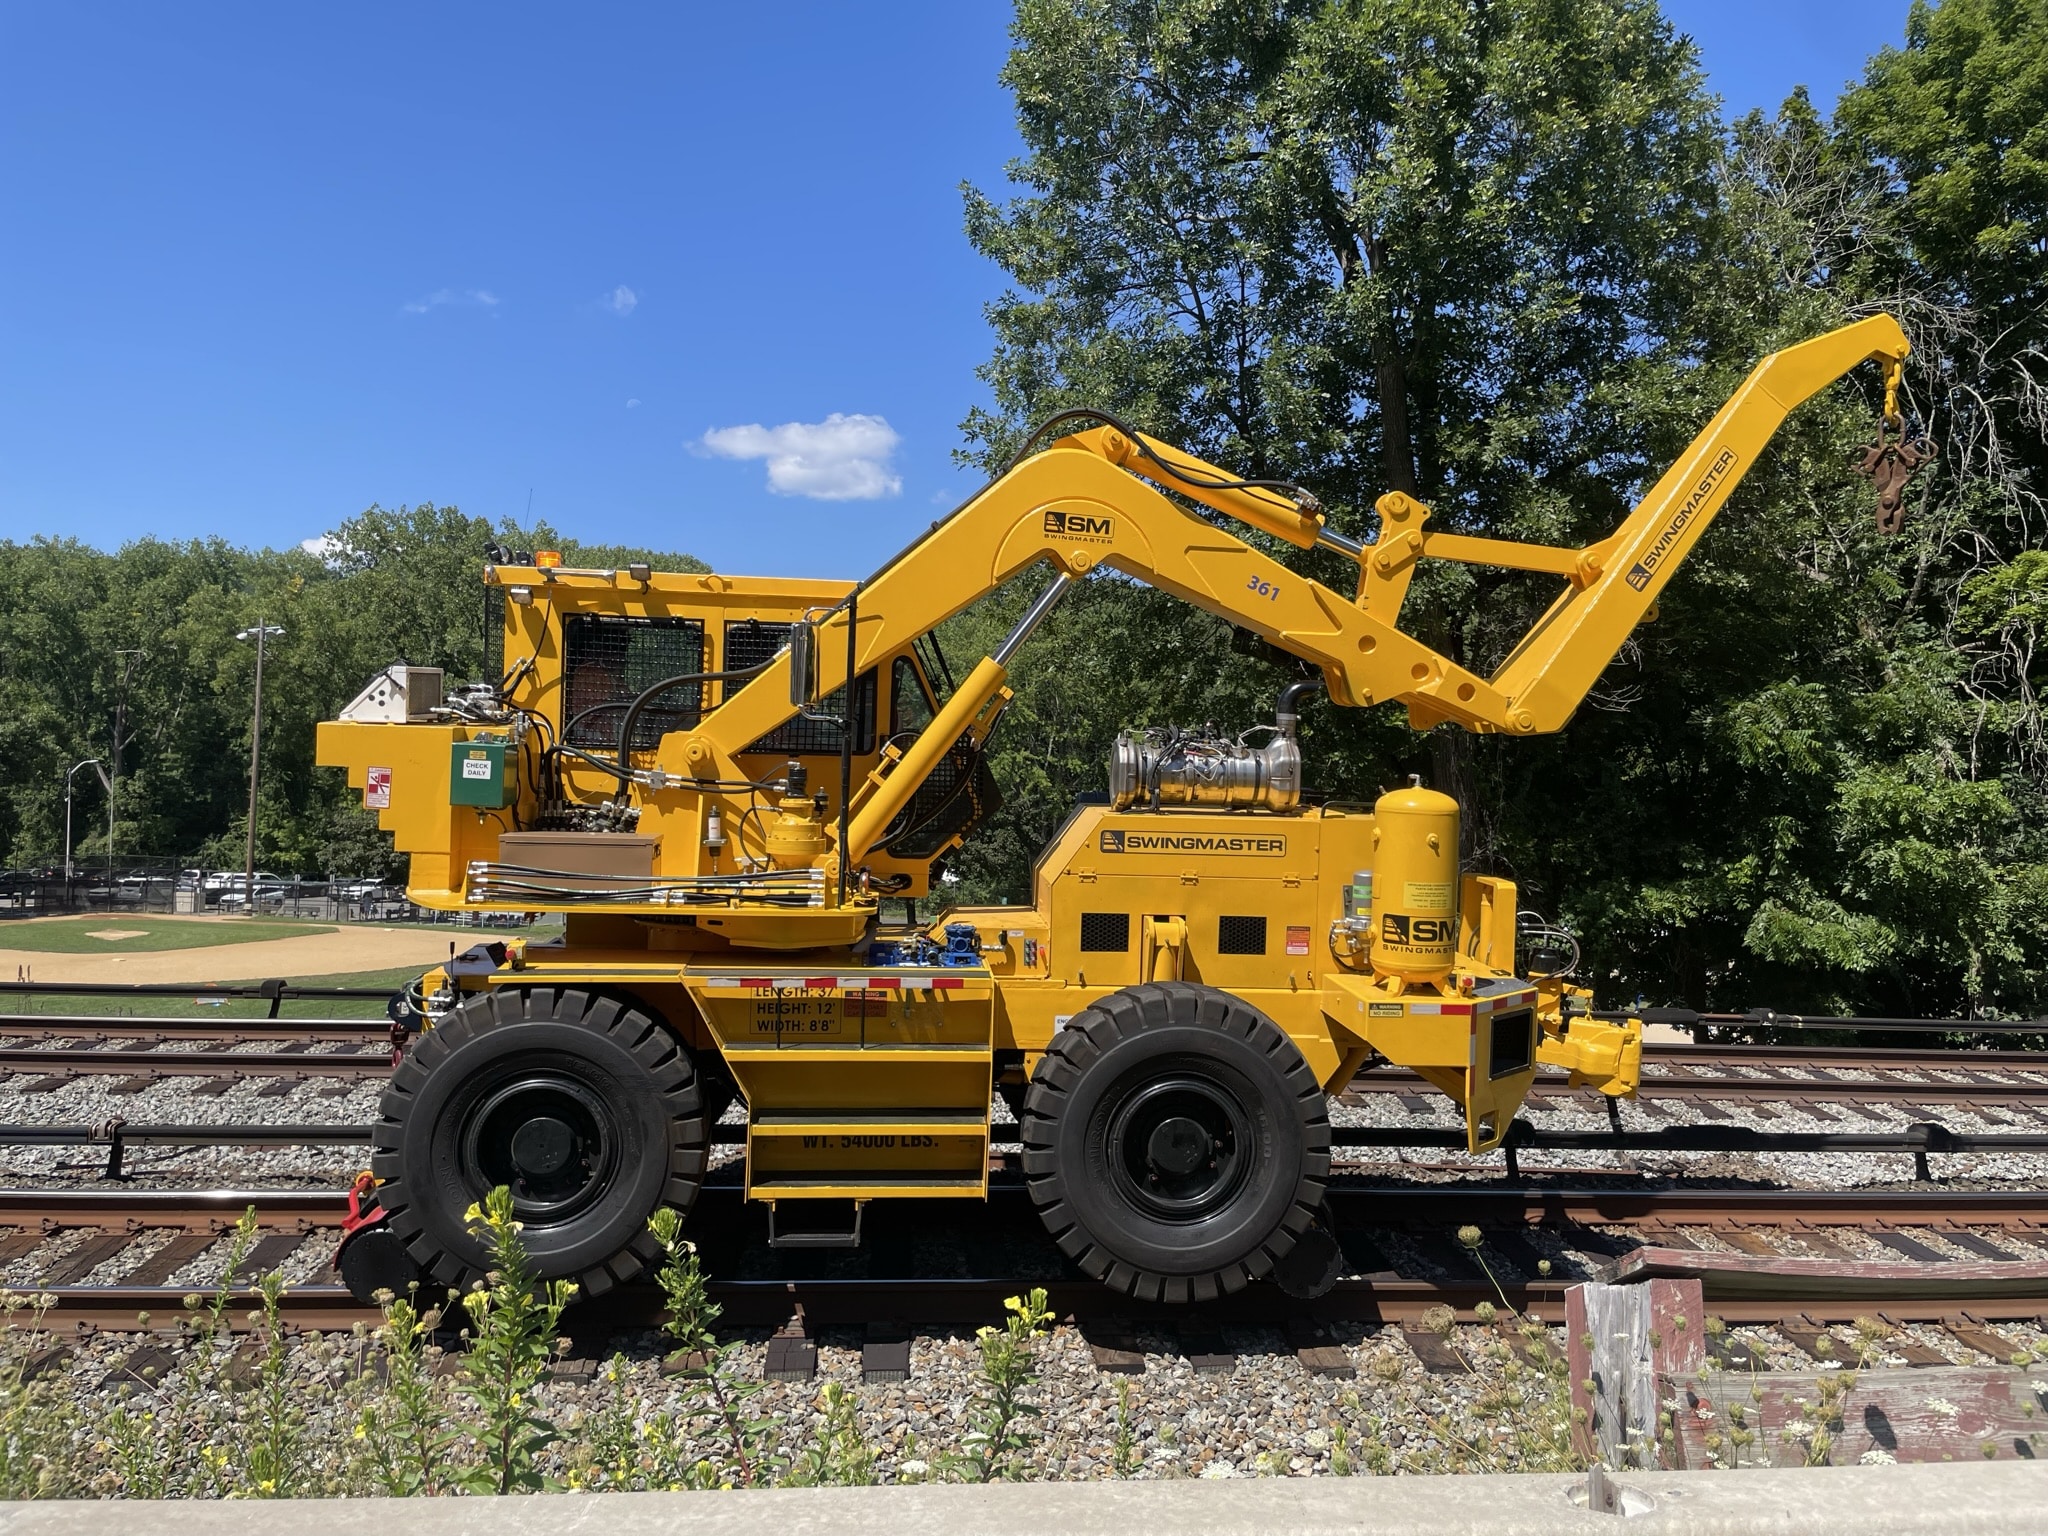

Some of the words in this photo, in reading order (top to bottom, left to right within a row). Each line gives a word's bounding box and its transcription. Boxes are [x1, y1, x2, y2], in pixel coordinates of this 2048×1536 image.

[1643, 451, 1734, 569] SWINGMASTER
[1067, 516, 1111, 535] SM
[1044, 533, 1113, 545] SWINGMASTER
[1247, 575, 1280, 601] 361
[1127, 836, 1283, 852] SWINGMASTER
[1412, 920, 1456, 942] SM
[1382, 943, 1456, 955] SWINGMAST
[756, 987, 813, 997] LENGTH:
[757, 1003, 811, 1015] HEIGHT:
[817, 1003, 836, 1015] 12'
[757, 1020, 805, 1032] WIDTH:
[841, 1135, 896, 1149] 54000
[901, 1135, 939, 1148] LBS.
